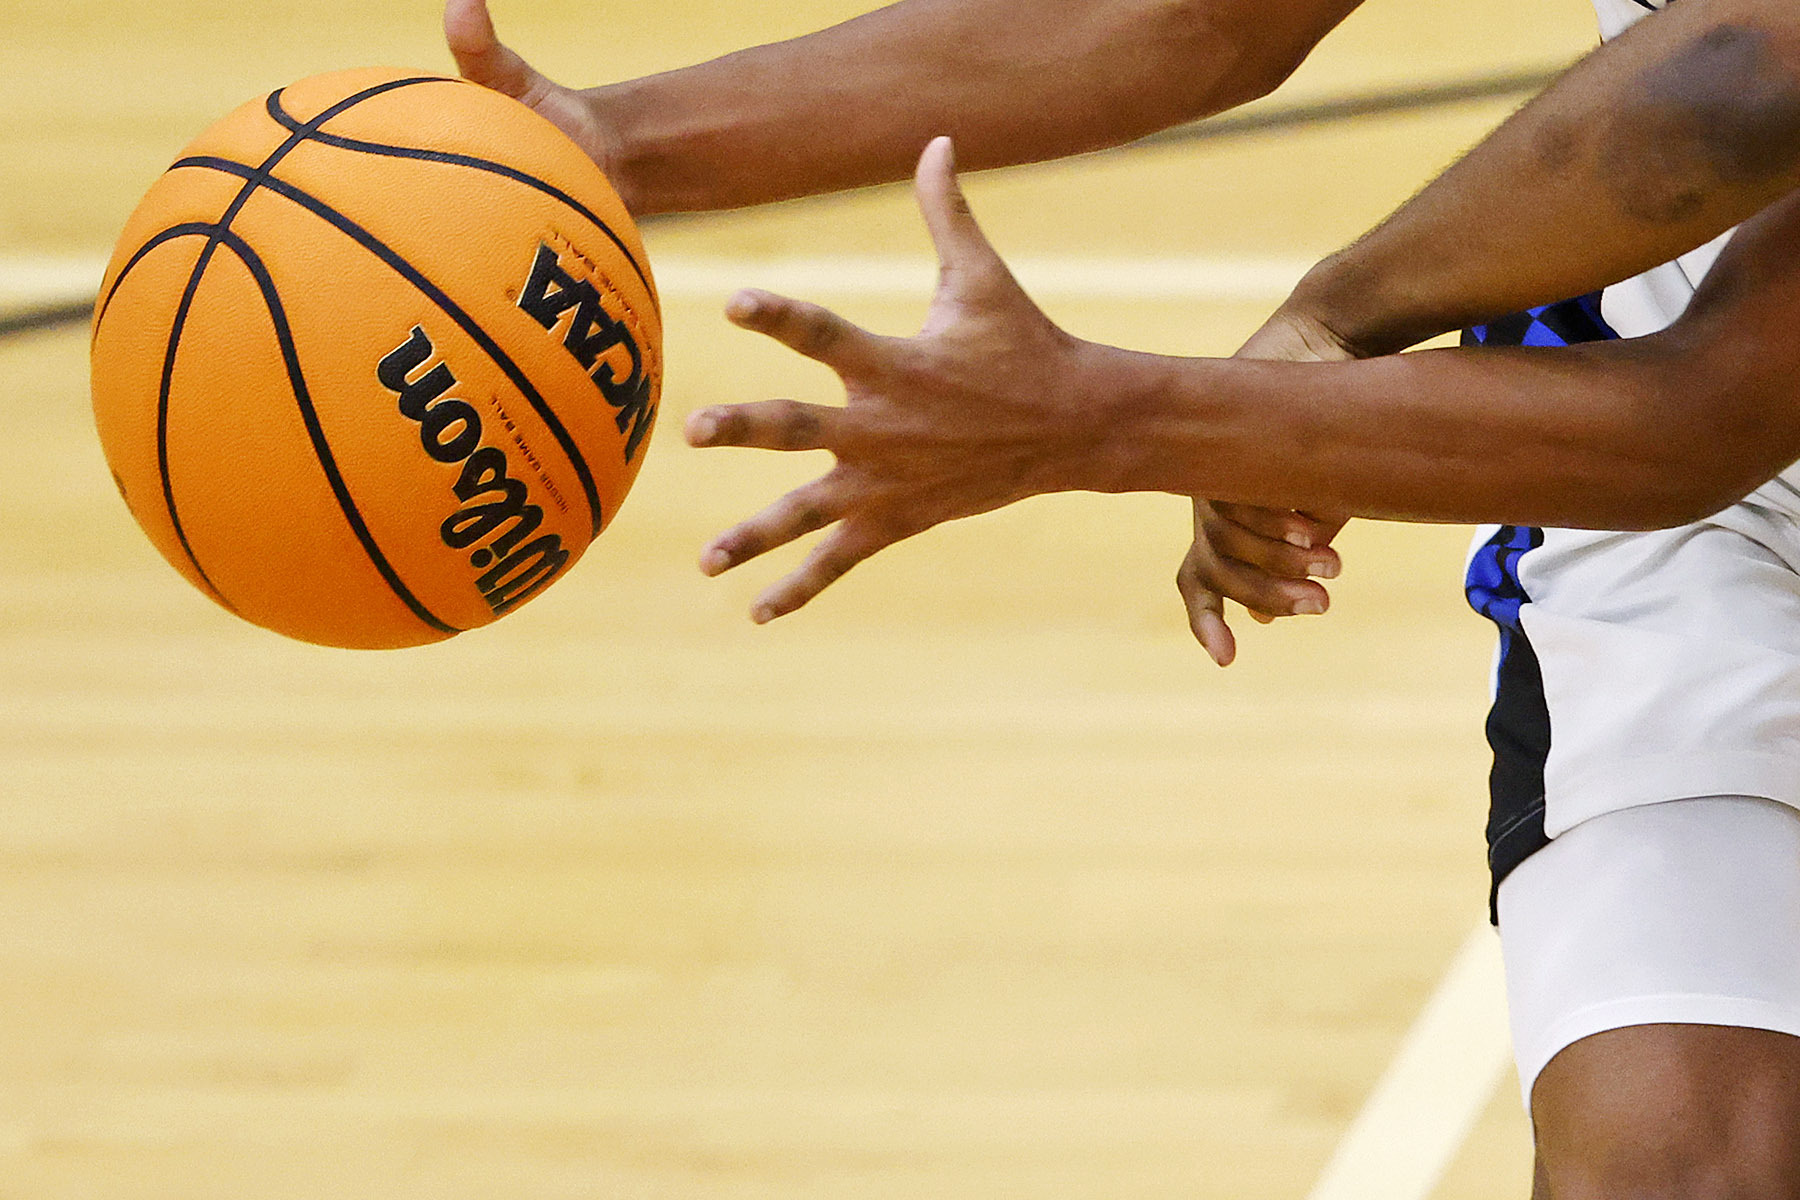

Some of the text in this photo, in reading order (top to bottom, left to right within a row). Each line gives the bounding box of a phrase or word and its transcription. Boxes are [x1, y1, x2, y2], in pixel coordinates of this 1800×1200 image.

[488, 397, 517, 433] BALL
[516, 239, 656, 467] NCAA
[377, 324, 570, 617] Wilson
[514, 434, 542, 472] GAME
